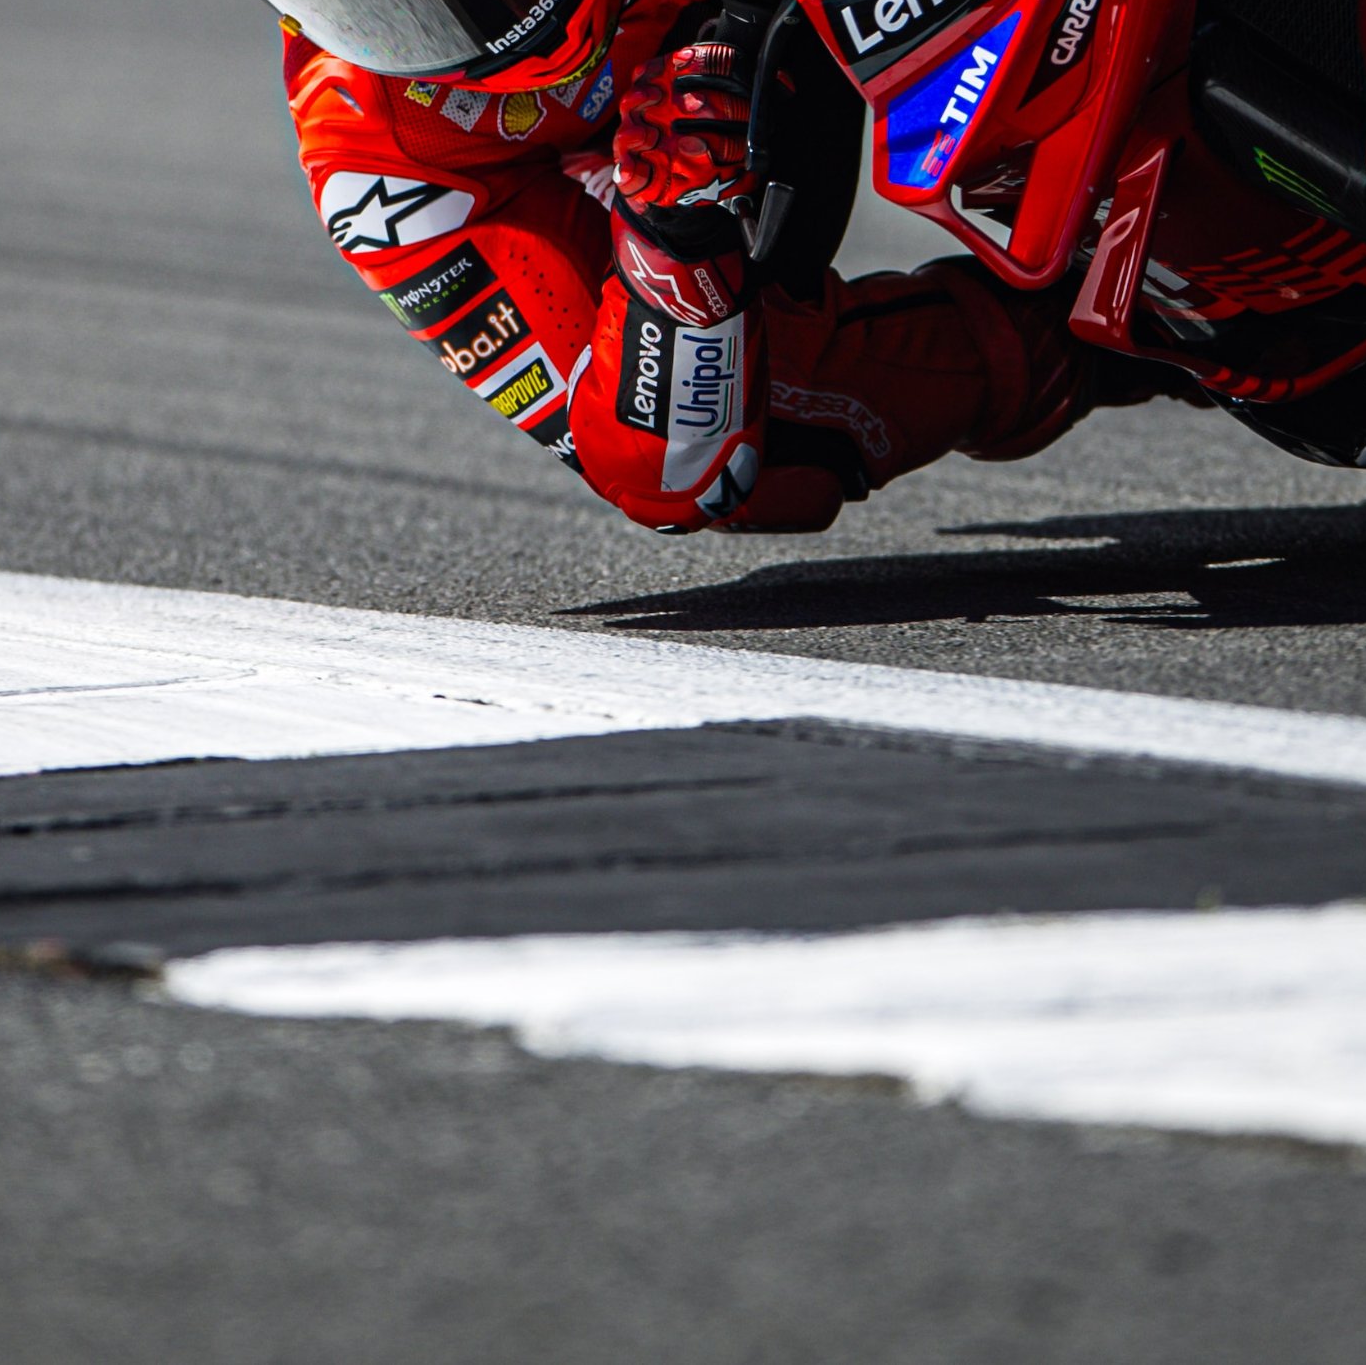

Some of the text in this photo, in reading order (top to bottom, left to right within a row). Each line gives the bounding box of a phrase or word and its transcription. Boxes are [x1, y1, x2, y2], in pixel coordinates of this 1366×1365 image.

[940, 44, 998, 125] TIM
[627, 321, 662, 429] Lenovo
[675, 333, 735, 428] Unipol
